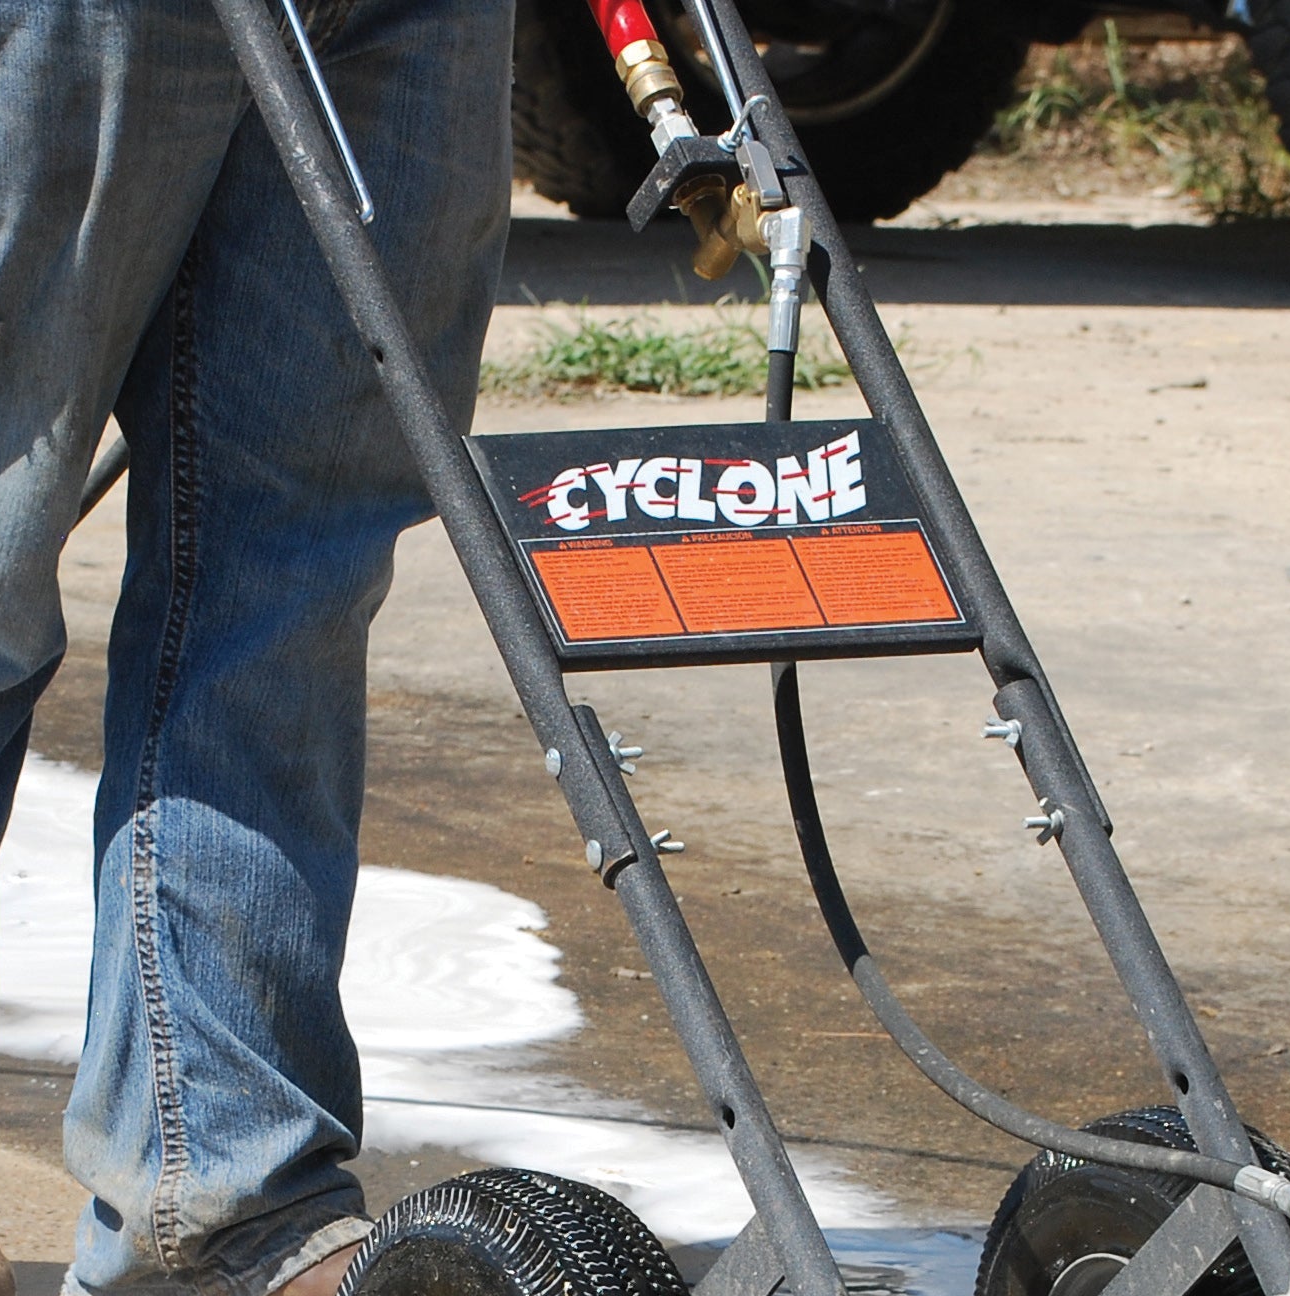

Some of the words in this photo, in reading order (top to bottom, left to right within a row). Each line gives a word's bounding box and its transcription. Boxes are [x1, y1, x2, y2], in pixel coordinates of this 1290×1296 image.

[545, 429, 867, 531] CYCLONE
[831, 524, 882, 535] ATTENTION
[566, 538, 615, 550] WARNING
